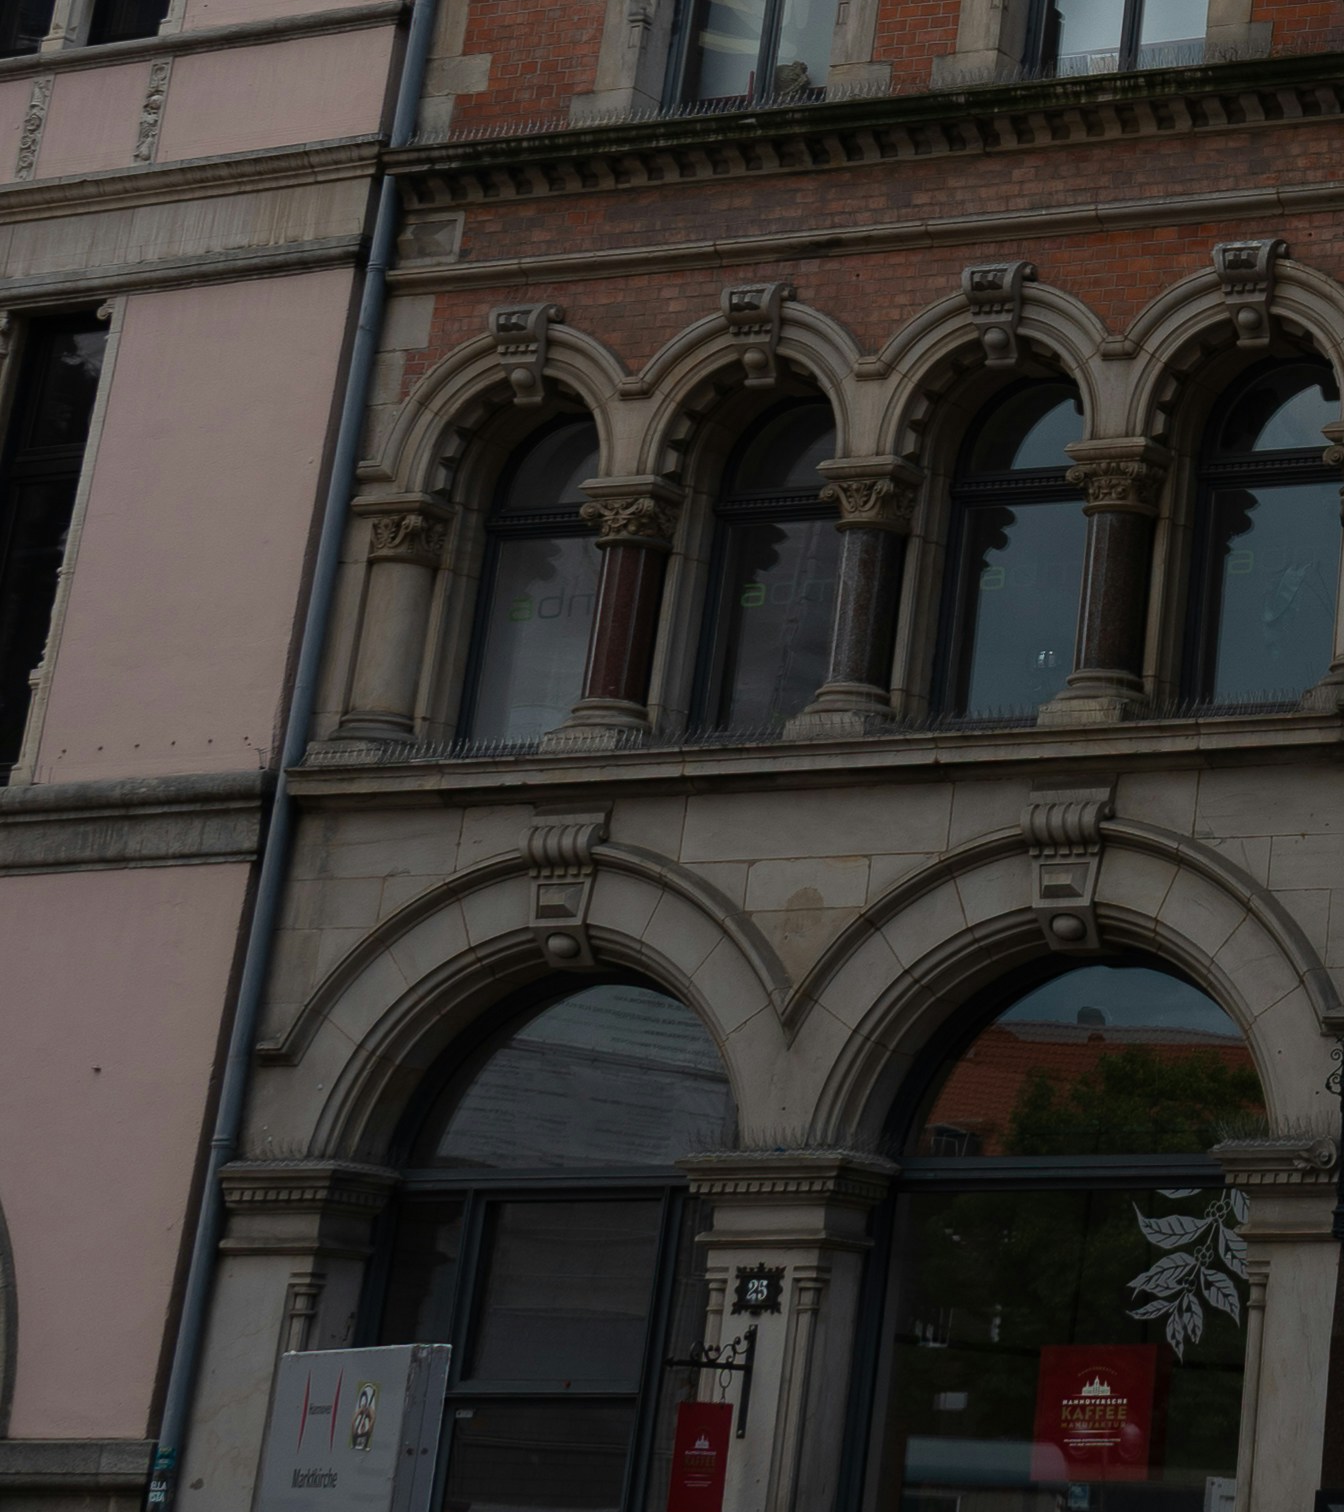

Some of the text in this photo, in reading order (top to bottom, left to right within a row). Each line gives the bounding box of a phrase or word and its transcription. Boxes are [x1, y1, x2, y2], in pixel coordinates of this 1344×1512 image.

[746, 1279, 769, 1301] 25
[1061, 1406, 1127, 1420] KAFFEE
[291, 1467, 338, 1488] Marktkirche
